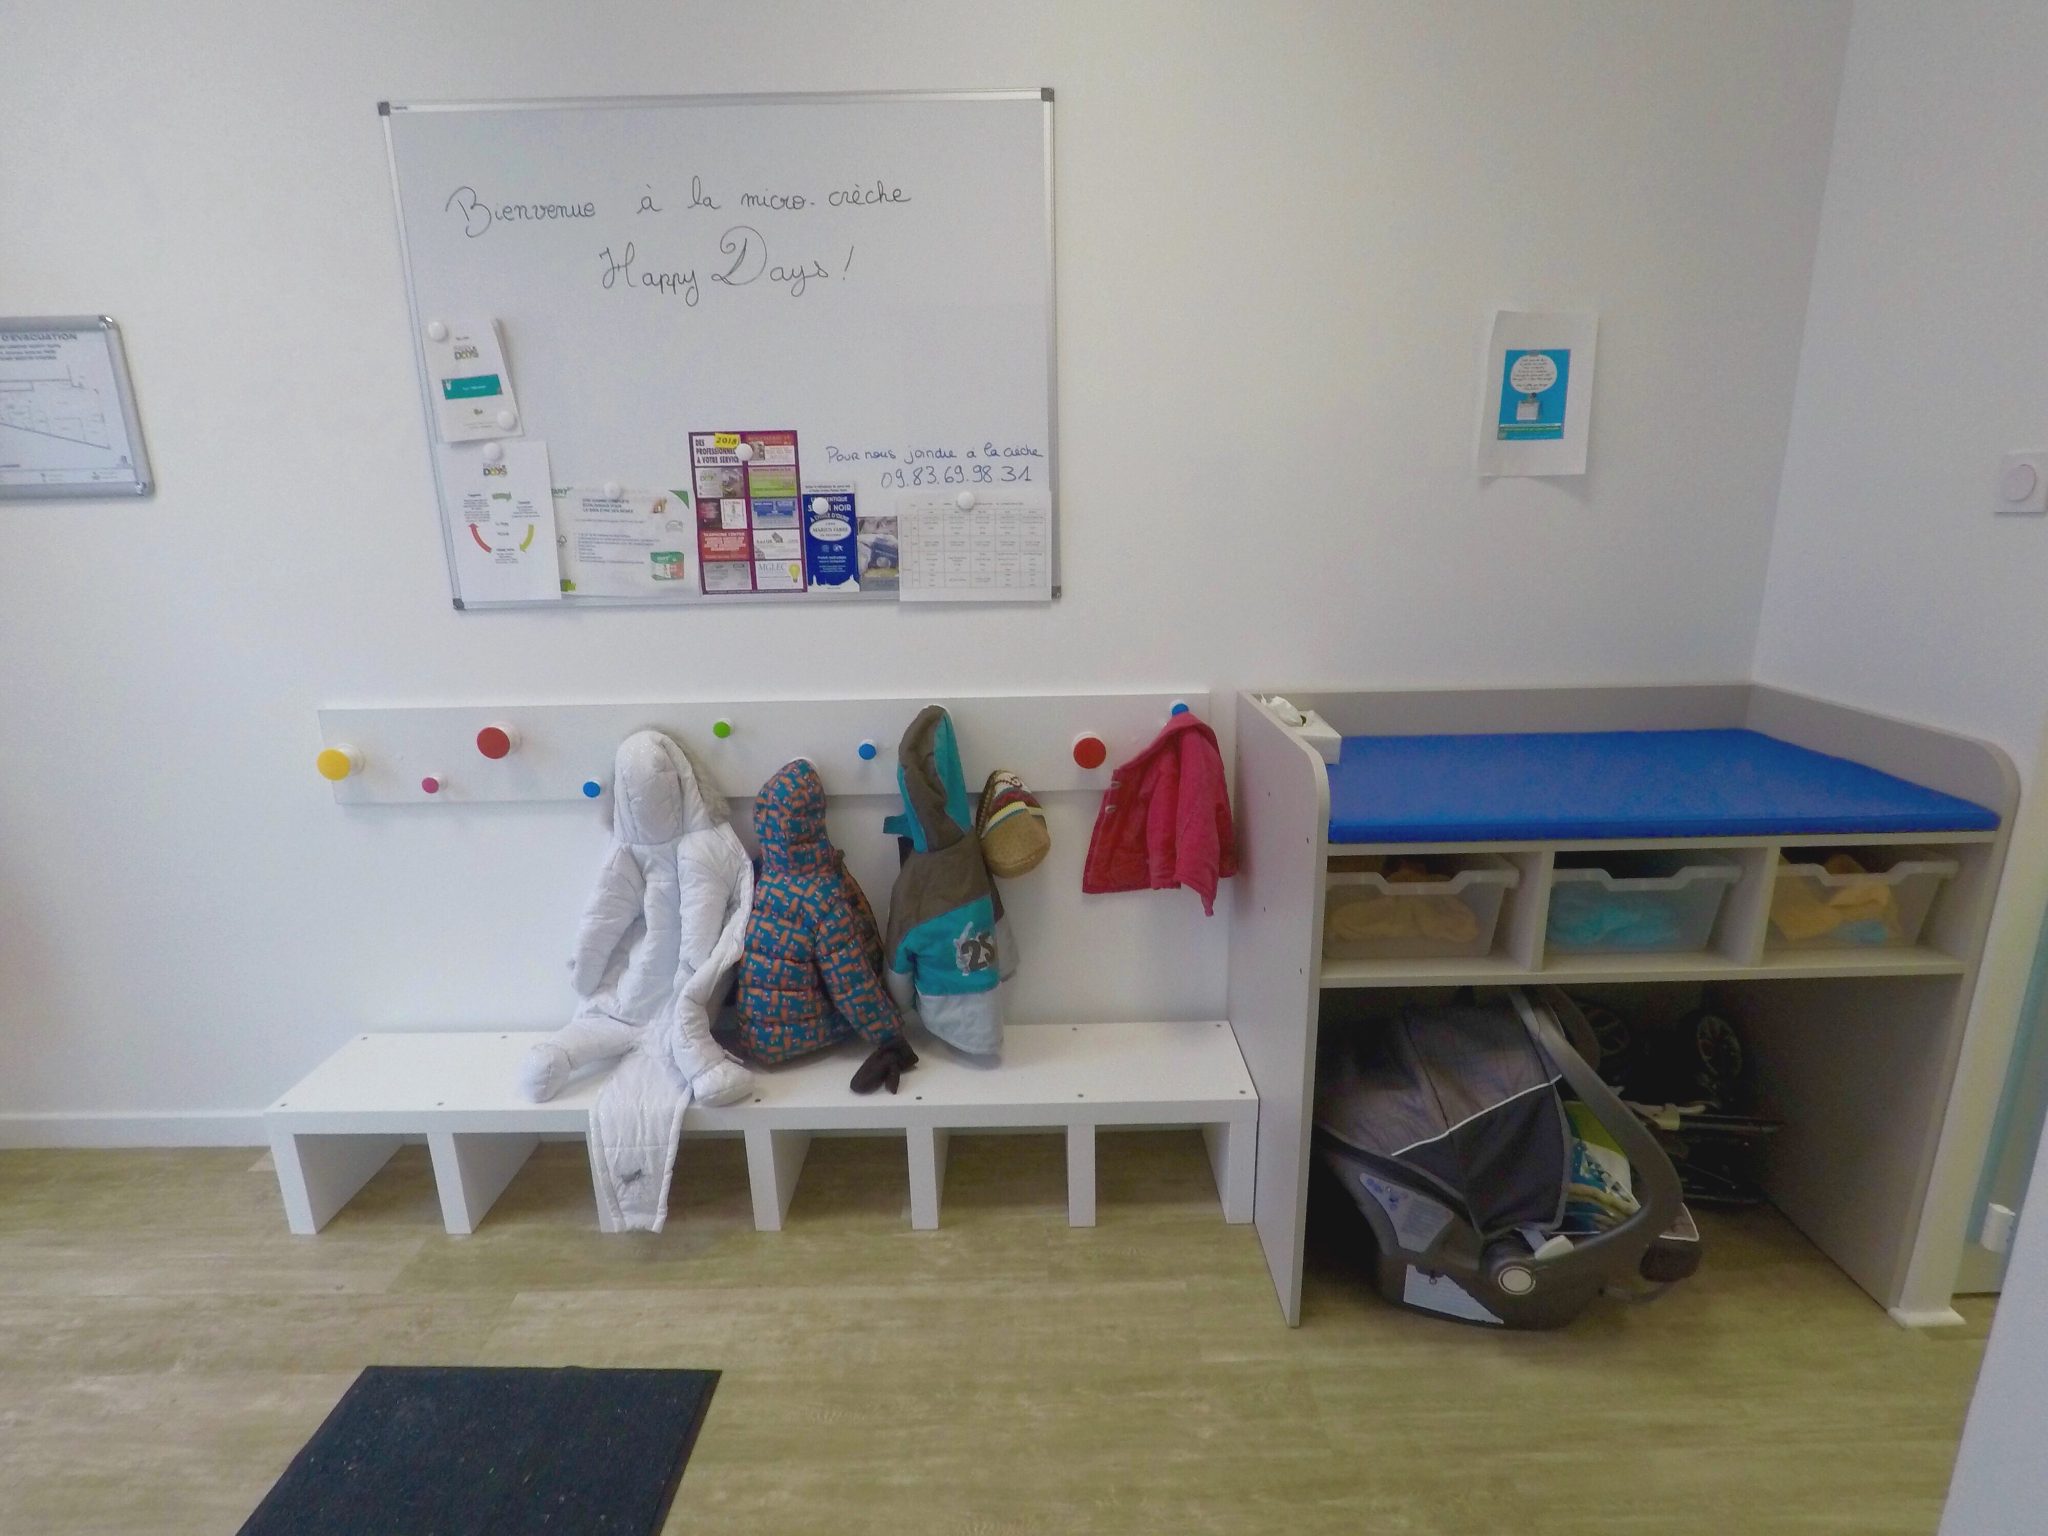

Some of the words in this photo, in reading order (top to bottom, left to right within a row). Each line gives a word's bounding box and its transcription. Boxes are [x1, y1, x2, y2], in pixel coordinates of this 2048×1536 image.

[445, 186, 596, 238] Bienvenue
[636, 184, 663, 214] à
[688, 175, 721, 210] la
[828, 180, 912, 207] crèche
[599, 241, 700, 307] Happy
[711, 226, 829, 297] Days
[695, 439, 705, 447] DES
[716, 436, 738, 445] 2018
[865, 449, 896, 460] nous
[983, 441, 1000, 457] la
[701, 456, 719, 464] VOTRE
[833, 504, 852, 512] NOIR
